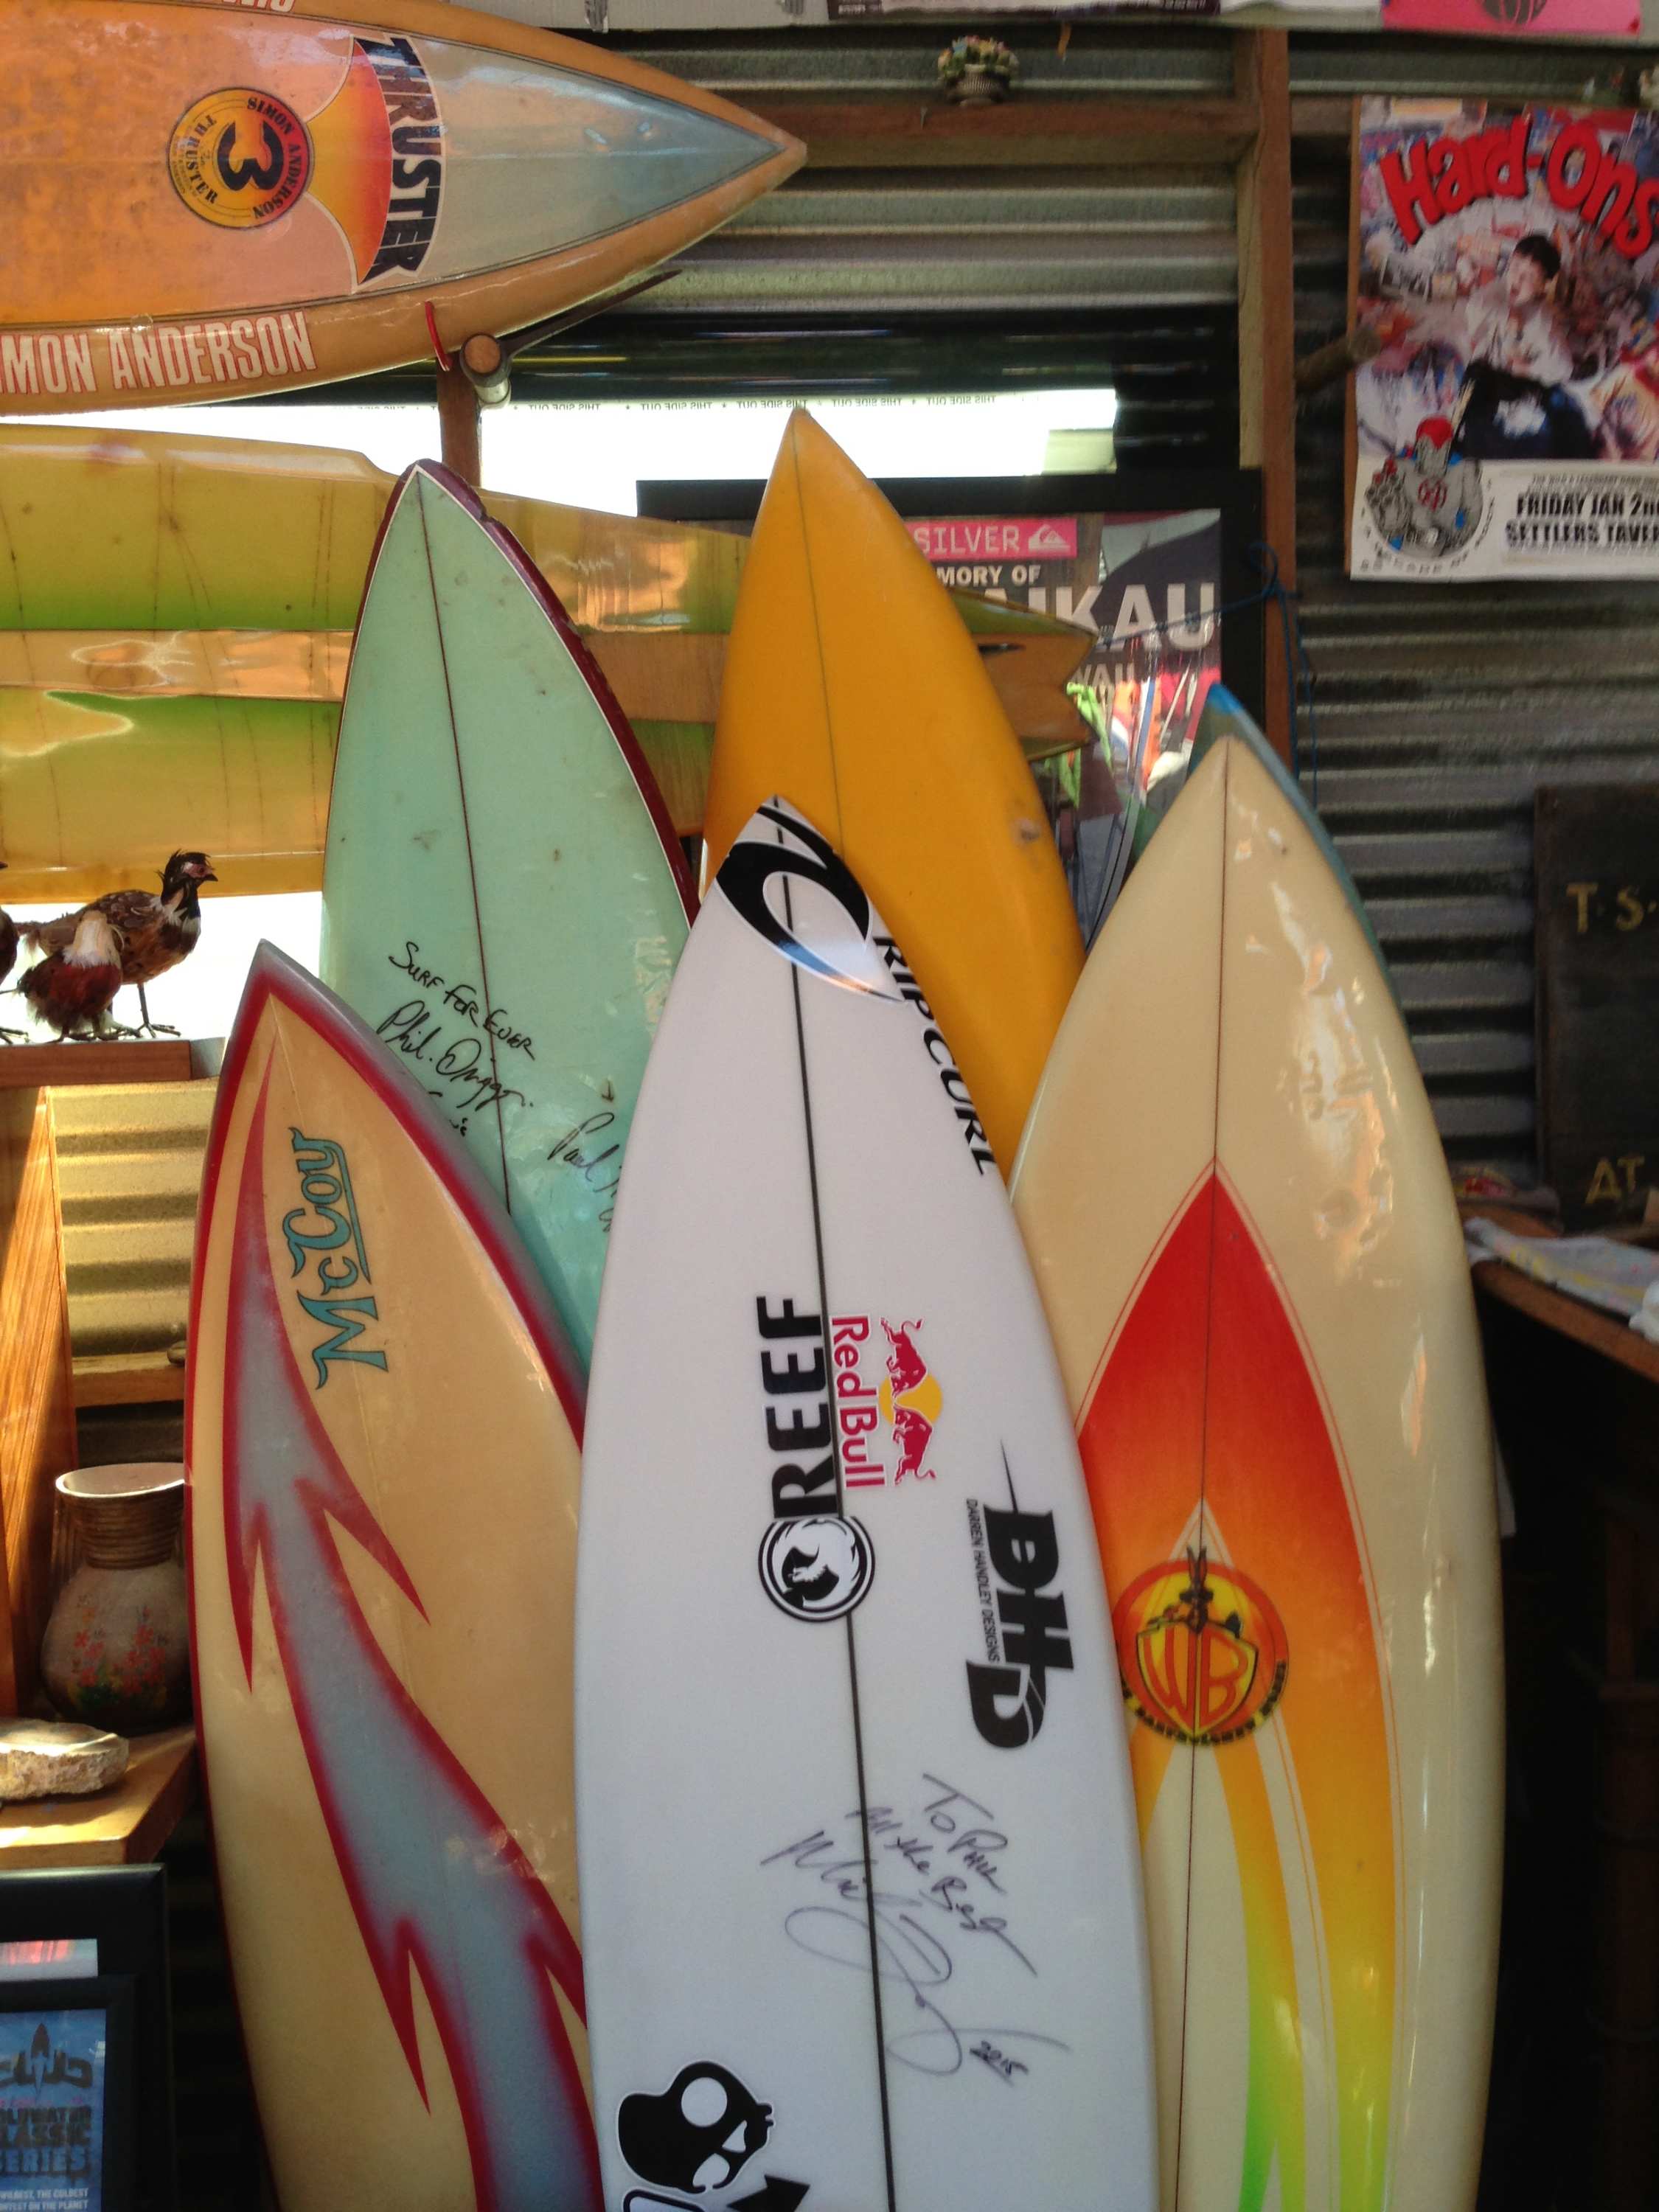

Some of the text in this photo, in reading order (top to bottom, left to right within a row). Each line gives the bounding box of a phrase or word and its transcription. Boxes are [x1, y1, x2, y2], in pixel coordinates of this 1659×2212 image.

[185, 114, 218, 204] THRUSTER
[247, 97, 302, 218] SIMON ANDERSON
[354, 37, 442, 285] THRUSTER
[1379, 114, 1659, 260] Hard-Ons
[106, 310, 316, 391] ANDERSON
[914, 524, 1021, 554] SILVER
[1517, 493, 1587, 515] FRIDAY
[1590, 493, 1625, 515] JAN
[1012, 565, 1041, 583] OF
[873, 935, 996, 1176] RIP CURL
[756, 1295, 840, 1519] REEF
[831, 1315, 886, 1488] Red Bull
[966, 1498, 1001, 1663] DARREN HANDLEY DESIGNS
